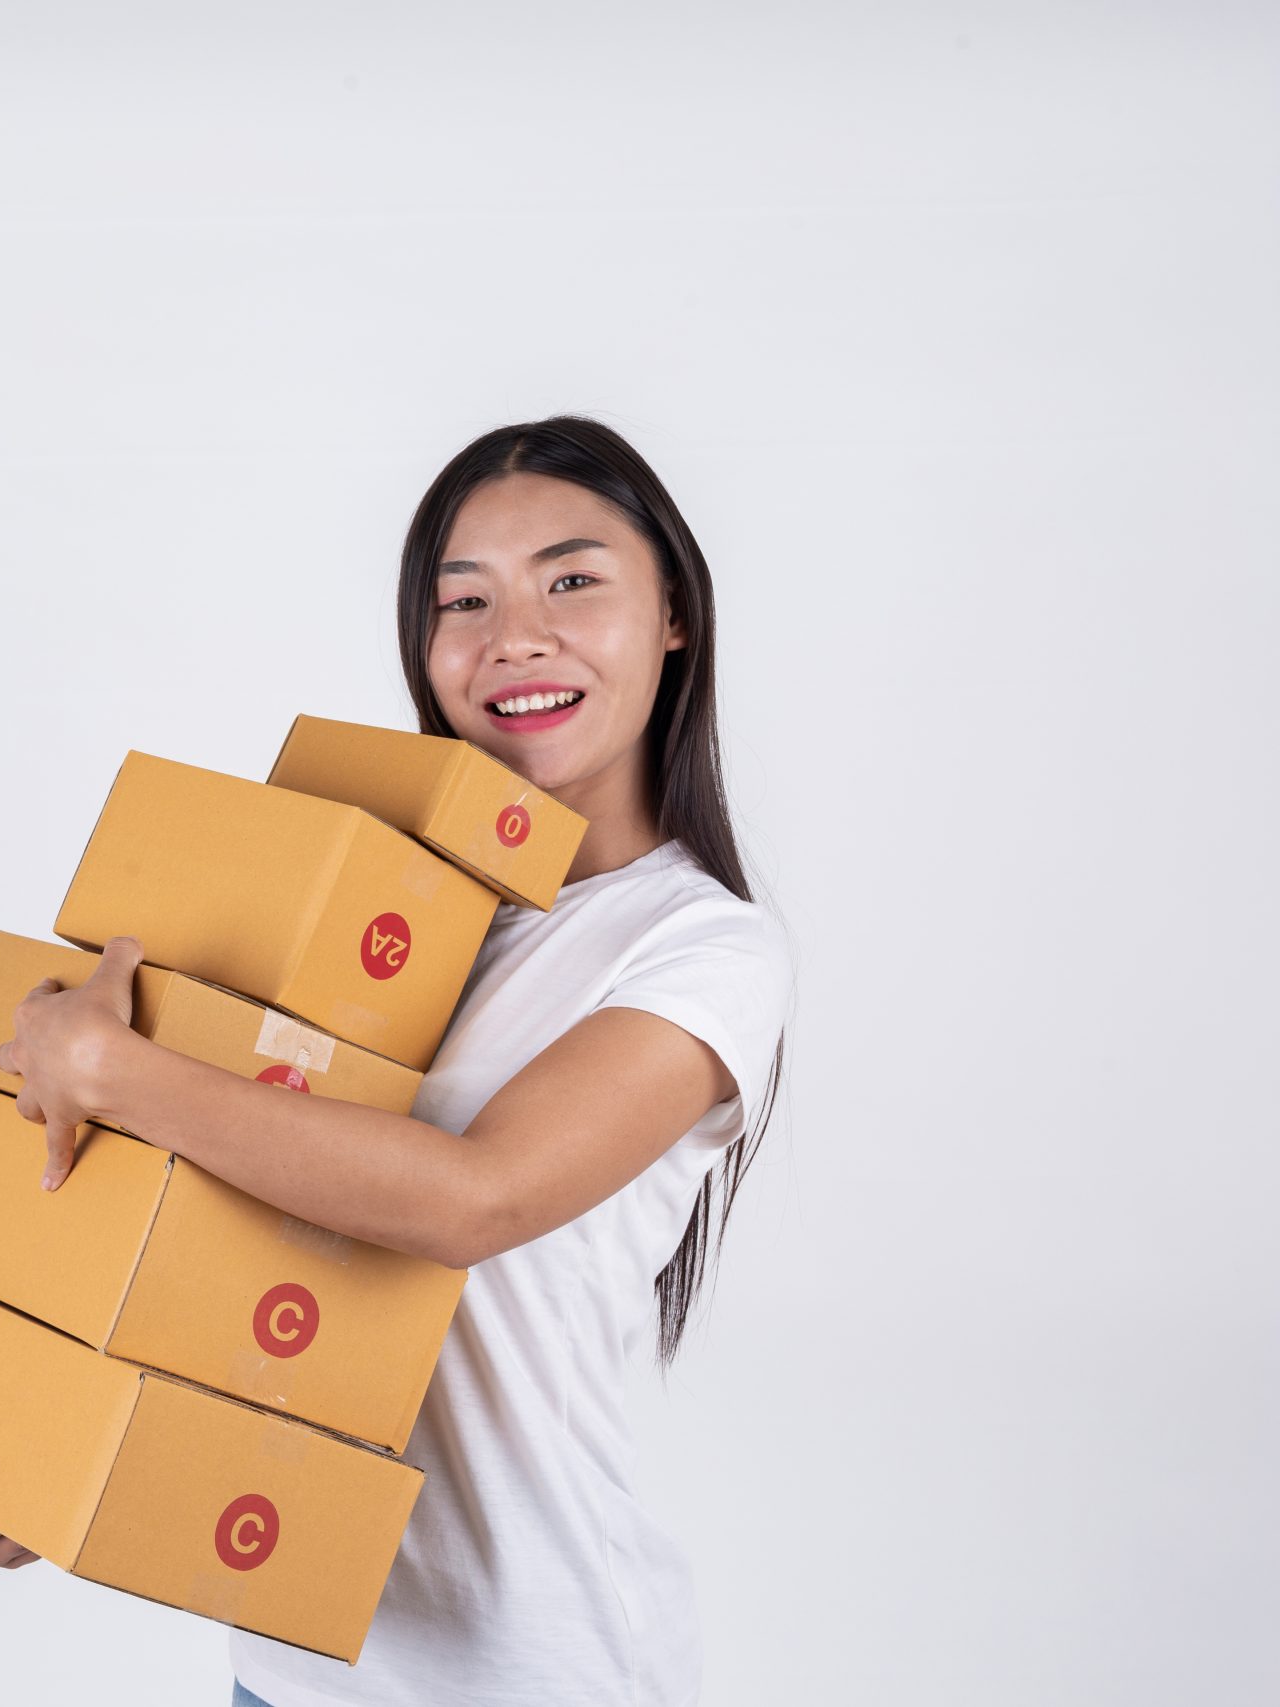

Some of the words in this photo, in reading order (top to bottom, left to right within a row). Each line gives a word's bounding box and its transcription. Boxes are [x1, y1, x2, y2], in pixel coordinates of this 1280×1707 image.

[371, 924, 408, 966] 2A
[269, 1301, 304, 1341] C
[231, 1513, 265, 1553] C
